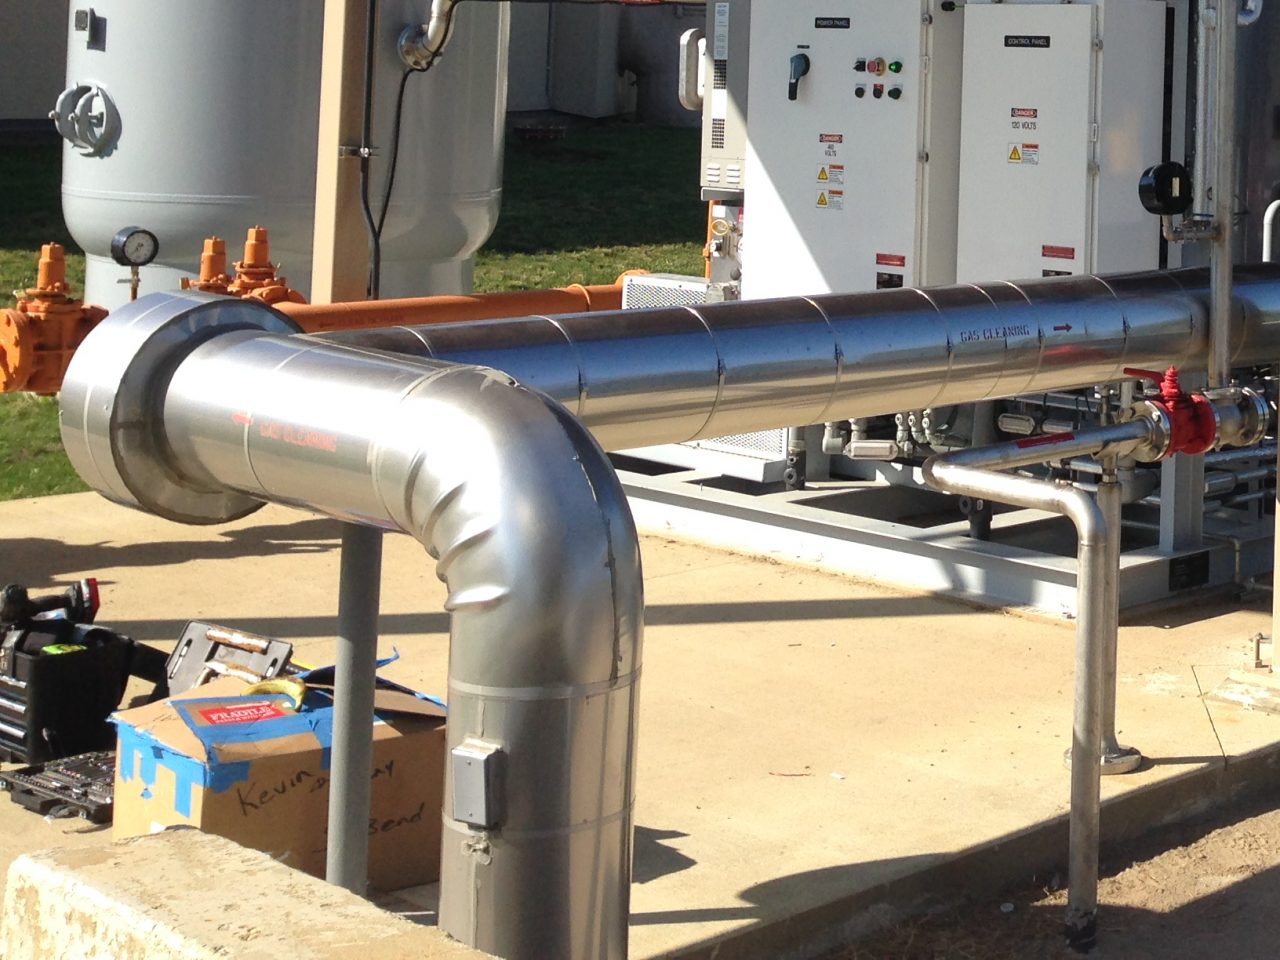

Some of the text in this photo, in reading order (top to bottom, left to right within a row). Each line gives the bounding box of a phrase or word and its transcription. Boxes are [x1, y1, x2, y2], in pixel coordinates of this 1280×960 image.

[1021, 121, 1037, 130] VOLTS
[960, 324, 1030, 342] GAS CLEANING
[210, 706, 271, 721] FRAGILE
[236, 770, 312, 818] Kevin
